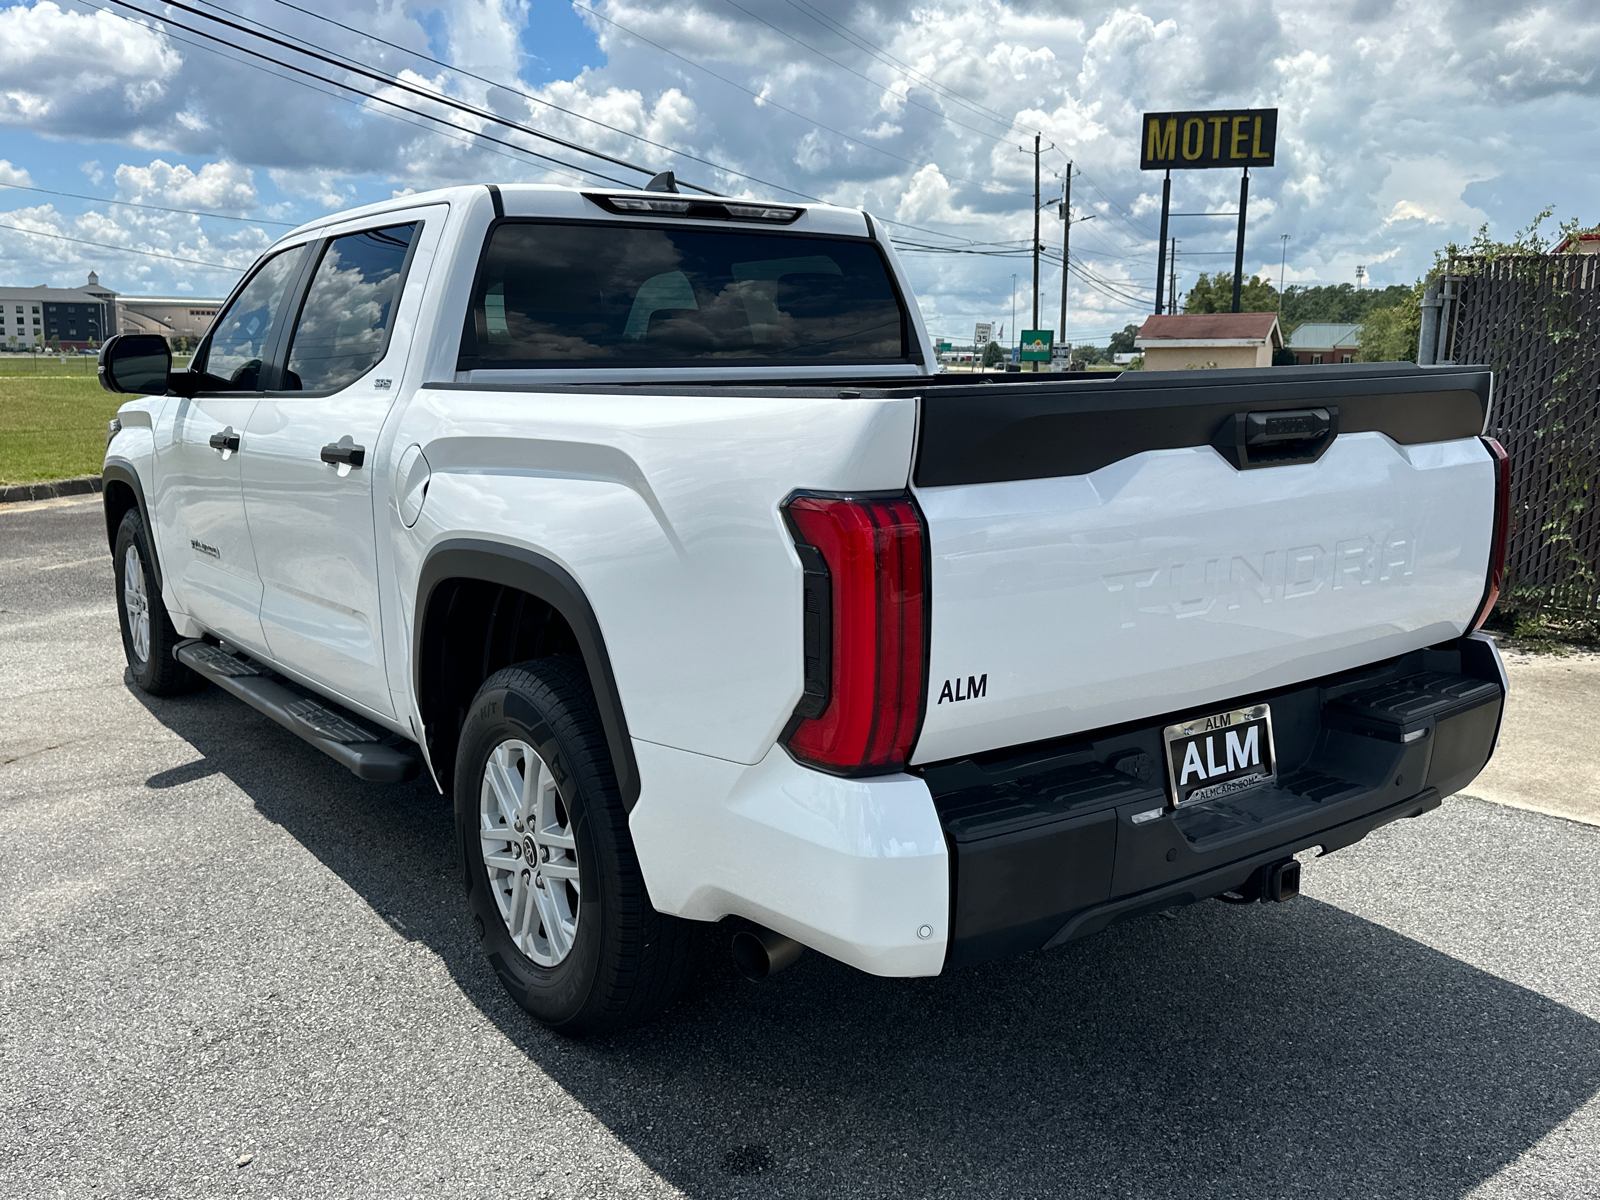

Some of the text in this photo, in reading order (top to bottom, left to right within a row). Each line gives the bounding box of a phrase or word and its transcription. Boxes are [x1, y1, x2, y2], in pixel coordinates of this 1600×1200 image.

[1146, 115, 1270, 161] MOTEL
[976, 335, 987, 343] 35
[1022, 342, 1050, 353] Budgetel
[1270, 418, 1309, 433] TOYOTA
[1098, 530, 1416, 628] TUNDRA
[937, 673, 988, 705] ALM
[480, 701, 497, 720] H/T
[1204, 712, 1231, 732] ALM
[1180, 725, 1260, 786] ALM
[1199, 776, 1255, 801] ALMCARS.COM
